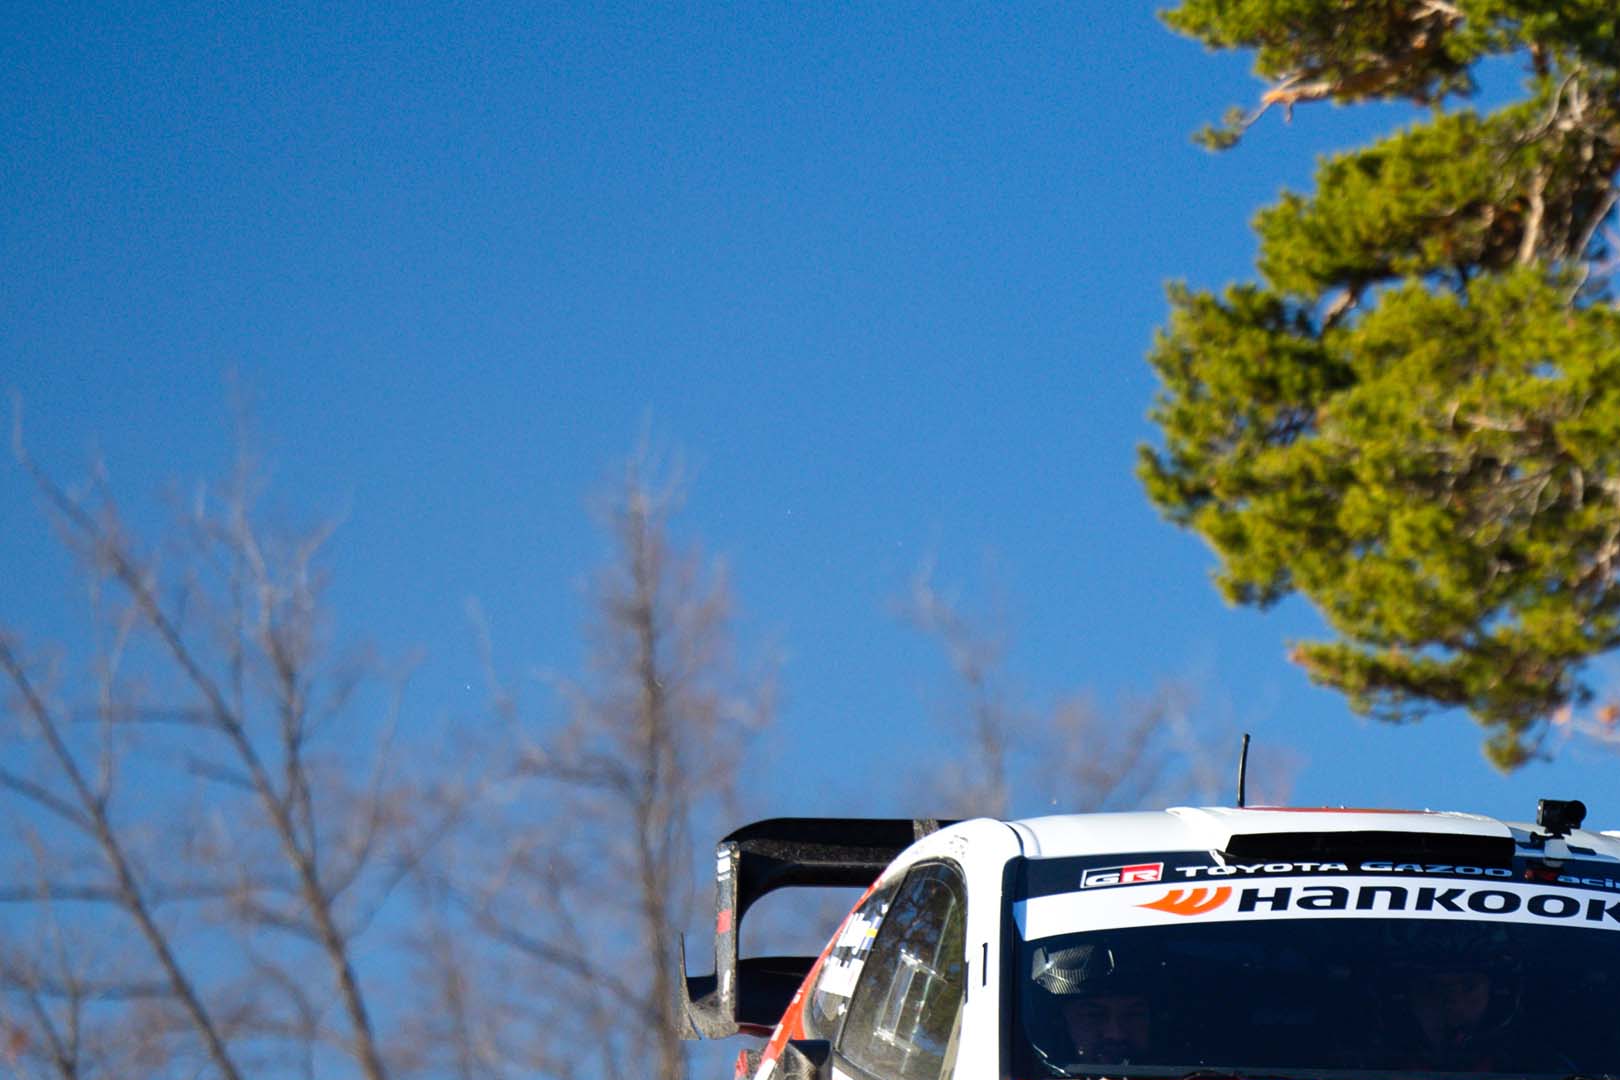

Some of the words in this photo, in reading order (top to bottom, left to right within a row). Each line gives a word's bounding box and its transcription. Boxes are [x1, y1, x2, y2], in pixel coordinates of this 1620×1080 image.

[1084, 866, 1159, 886] GR
[1175, 863, 1348, 877] TOYOTA
[1360, 862, 1513, 877] GAZOO
